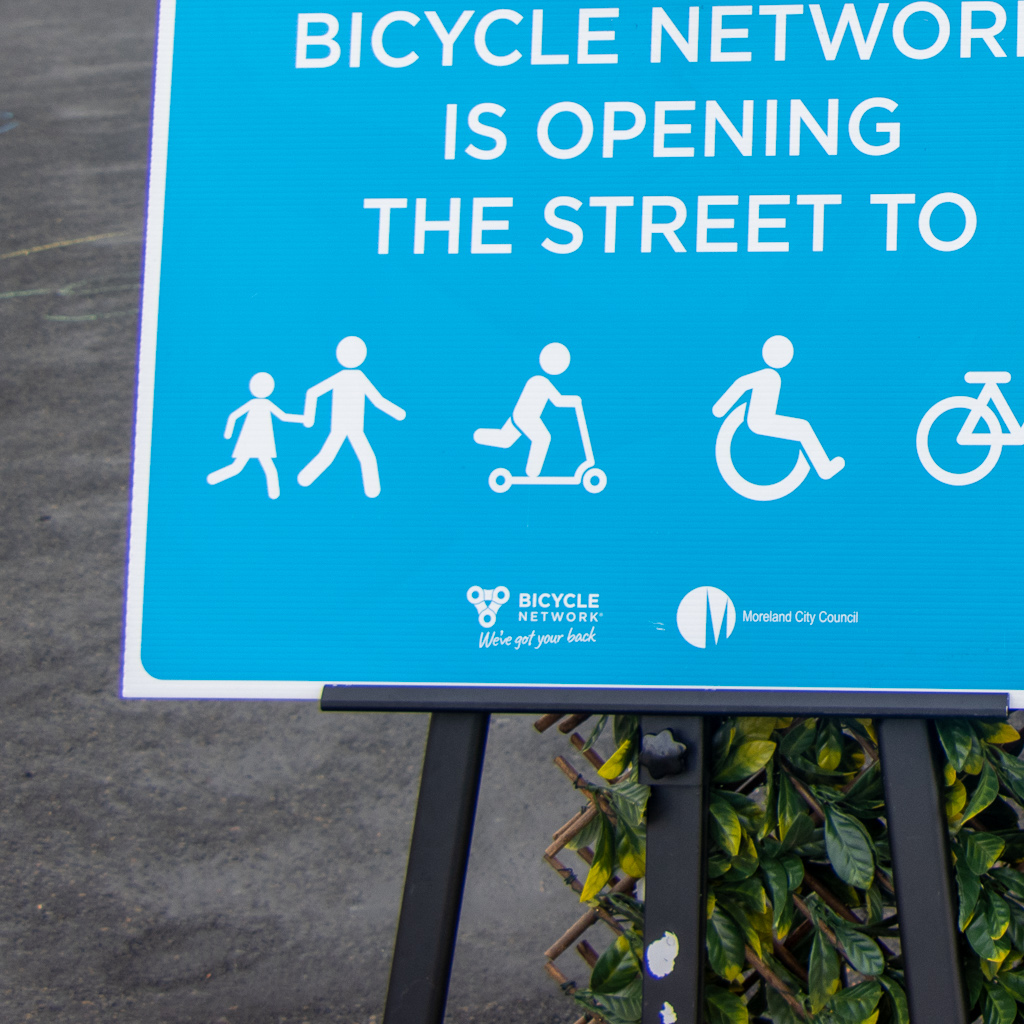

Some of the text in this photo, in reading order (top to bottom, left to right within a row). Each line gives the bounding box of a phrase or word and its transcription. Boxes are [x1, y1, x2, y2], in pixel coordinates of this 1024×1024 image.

[296, 7, 620, 69] BICYCLE
[444, 97, 901, 162] IS OPENING
[363, 192, 978, 256] THE STREET TO
[518, 592, 600, 609] BICYCLE
[742, 609, 859, 627] Moreland City Council
[478, 626, 597, 650] We've got your back
